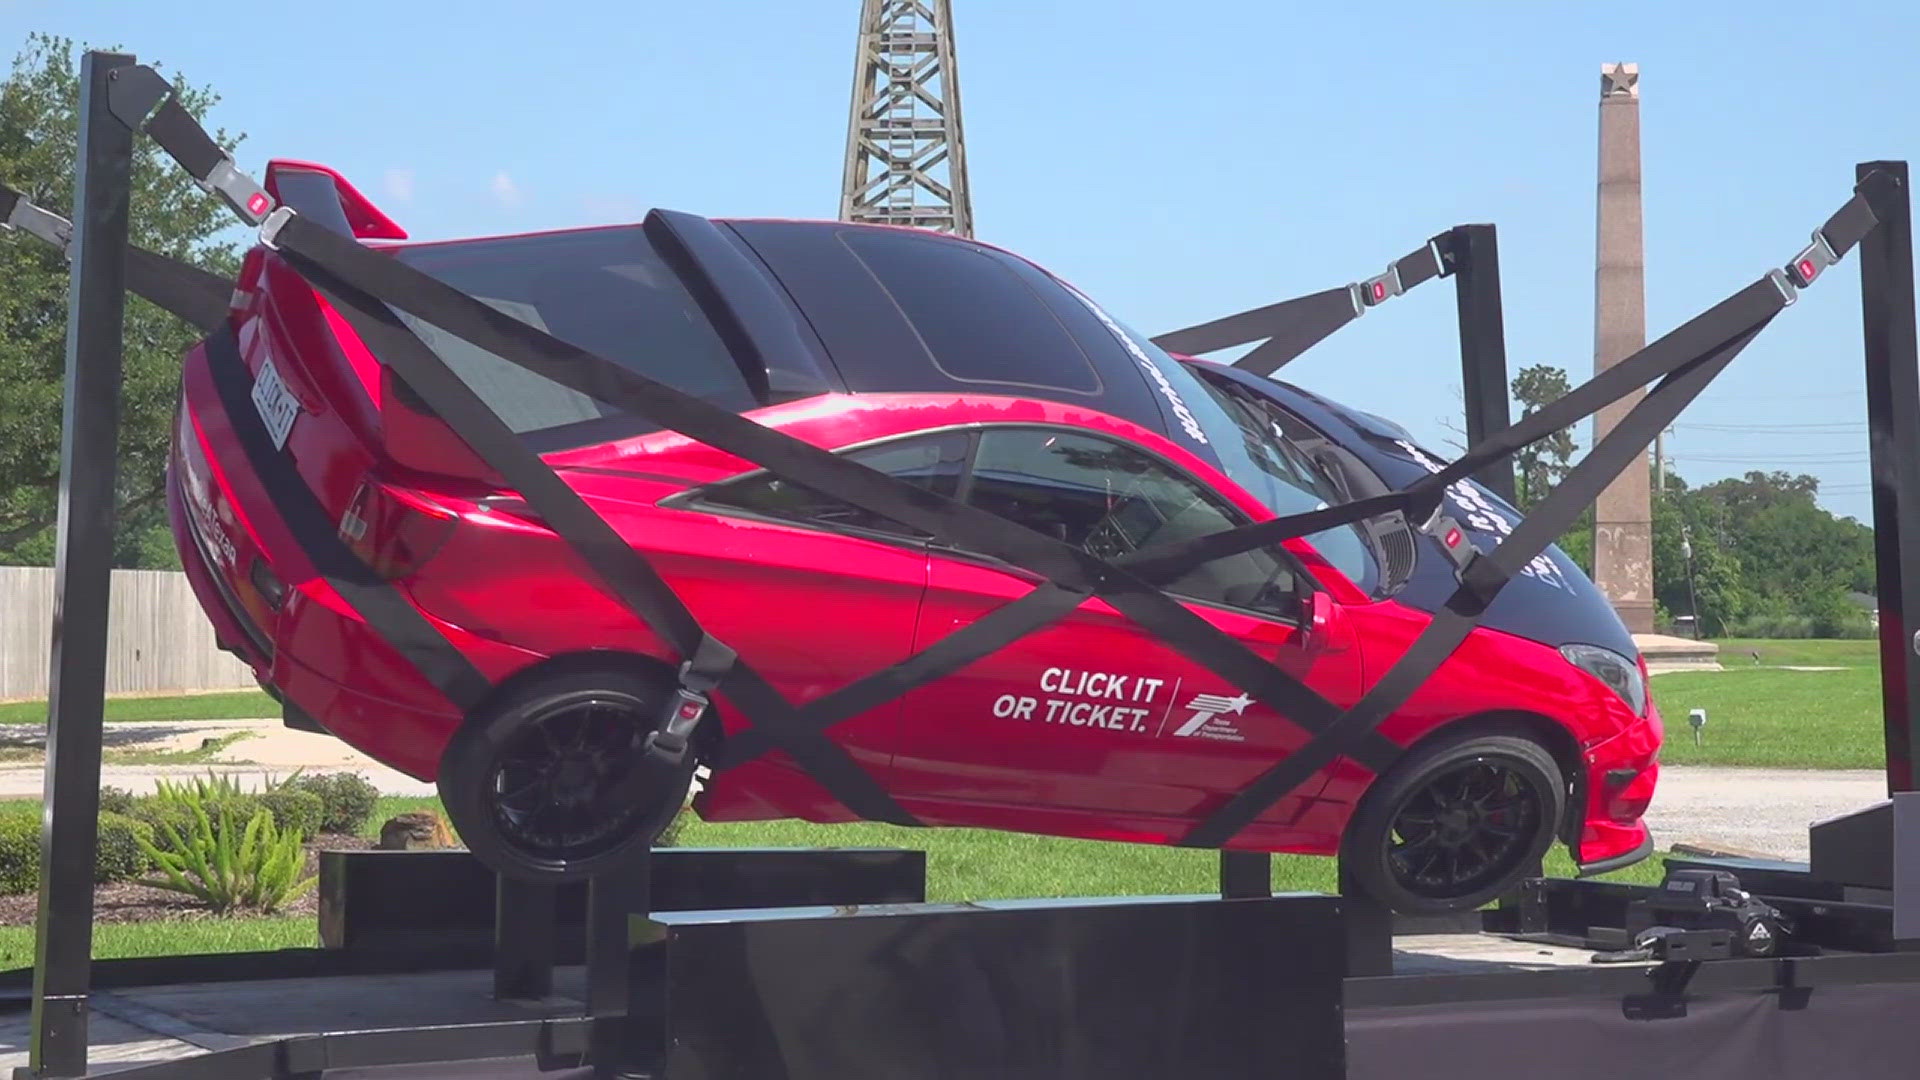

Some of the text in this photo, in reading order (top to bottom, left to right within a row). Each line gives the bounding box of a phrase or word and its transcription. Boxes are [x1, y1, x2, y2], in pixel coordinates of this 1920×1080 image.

[1040, 667, 1164, 703] CLICK IT
[993, 694, 1149, 733] OR TICKET.
